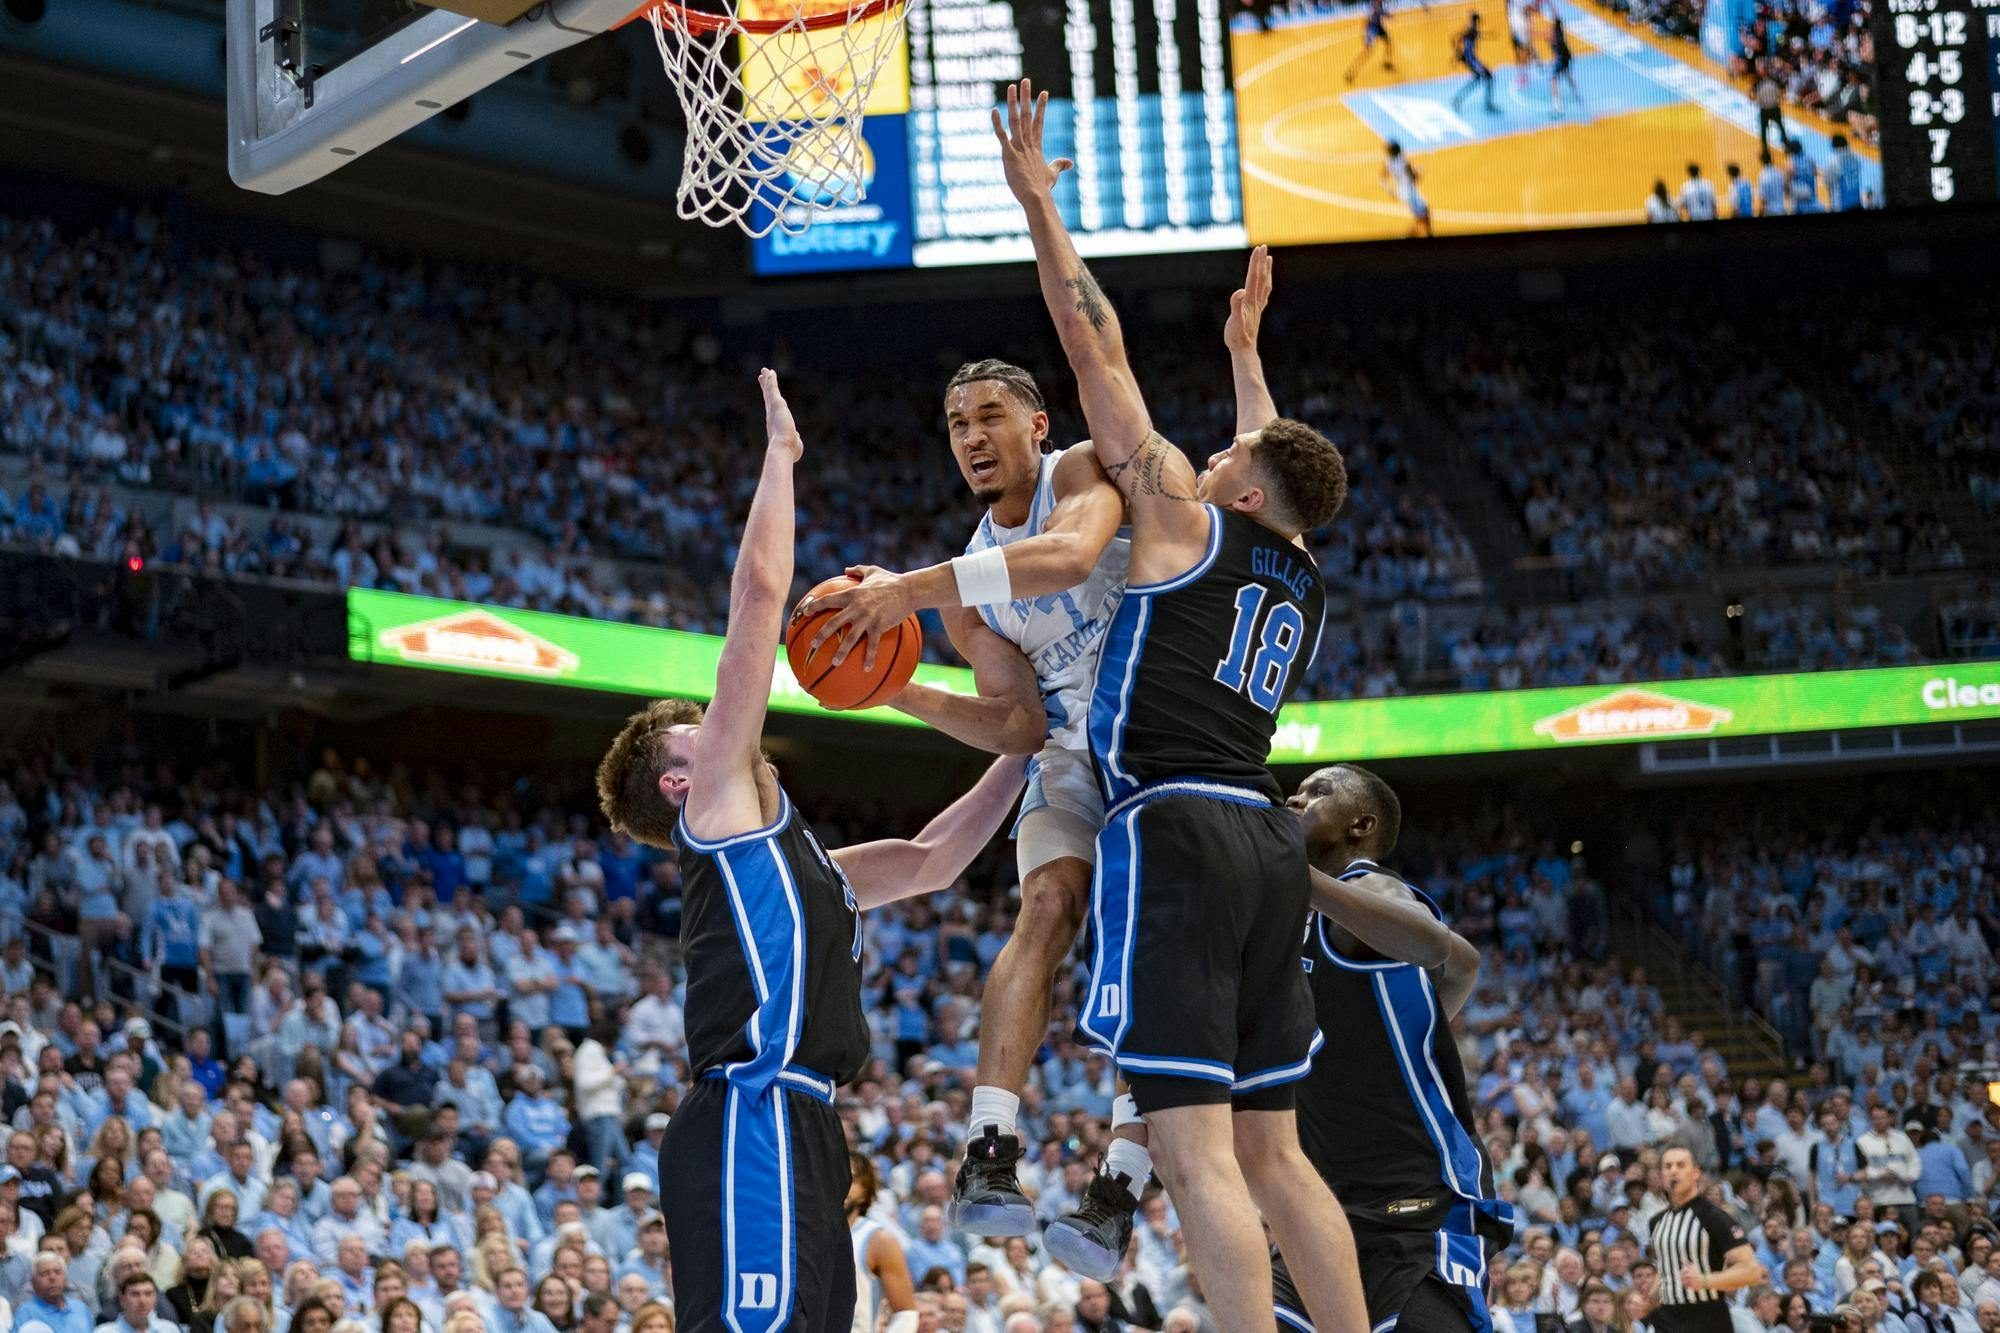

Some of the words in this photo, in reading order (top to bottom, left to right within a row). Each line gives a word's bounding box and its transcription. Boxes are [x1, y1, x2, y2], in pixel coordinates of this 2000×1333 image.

[1905, 50, 1963, 86] 4-5
[1908, 88, 1965, 125] 2-3
[1928, 128, 1951, 164] 7
[1930, 166, 1955, 202] 5
[1252, 546, 1313, 601] GILLIS
[1213, 582, 1304, 715] 18
[1922, 677, 2000, 709] Clea
[739, 1272, 777, 1308] D
